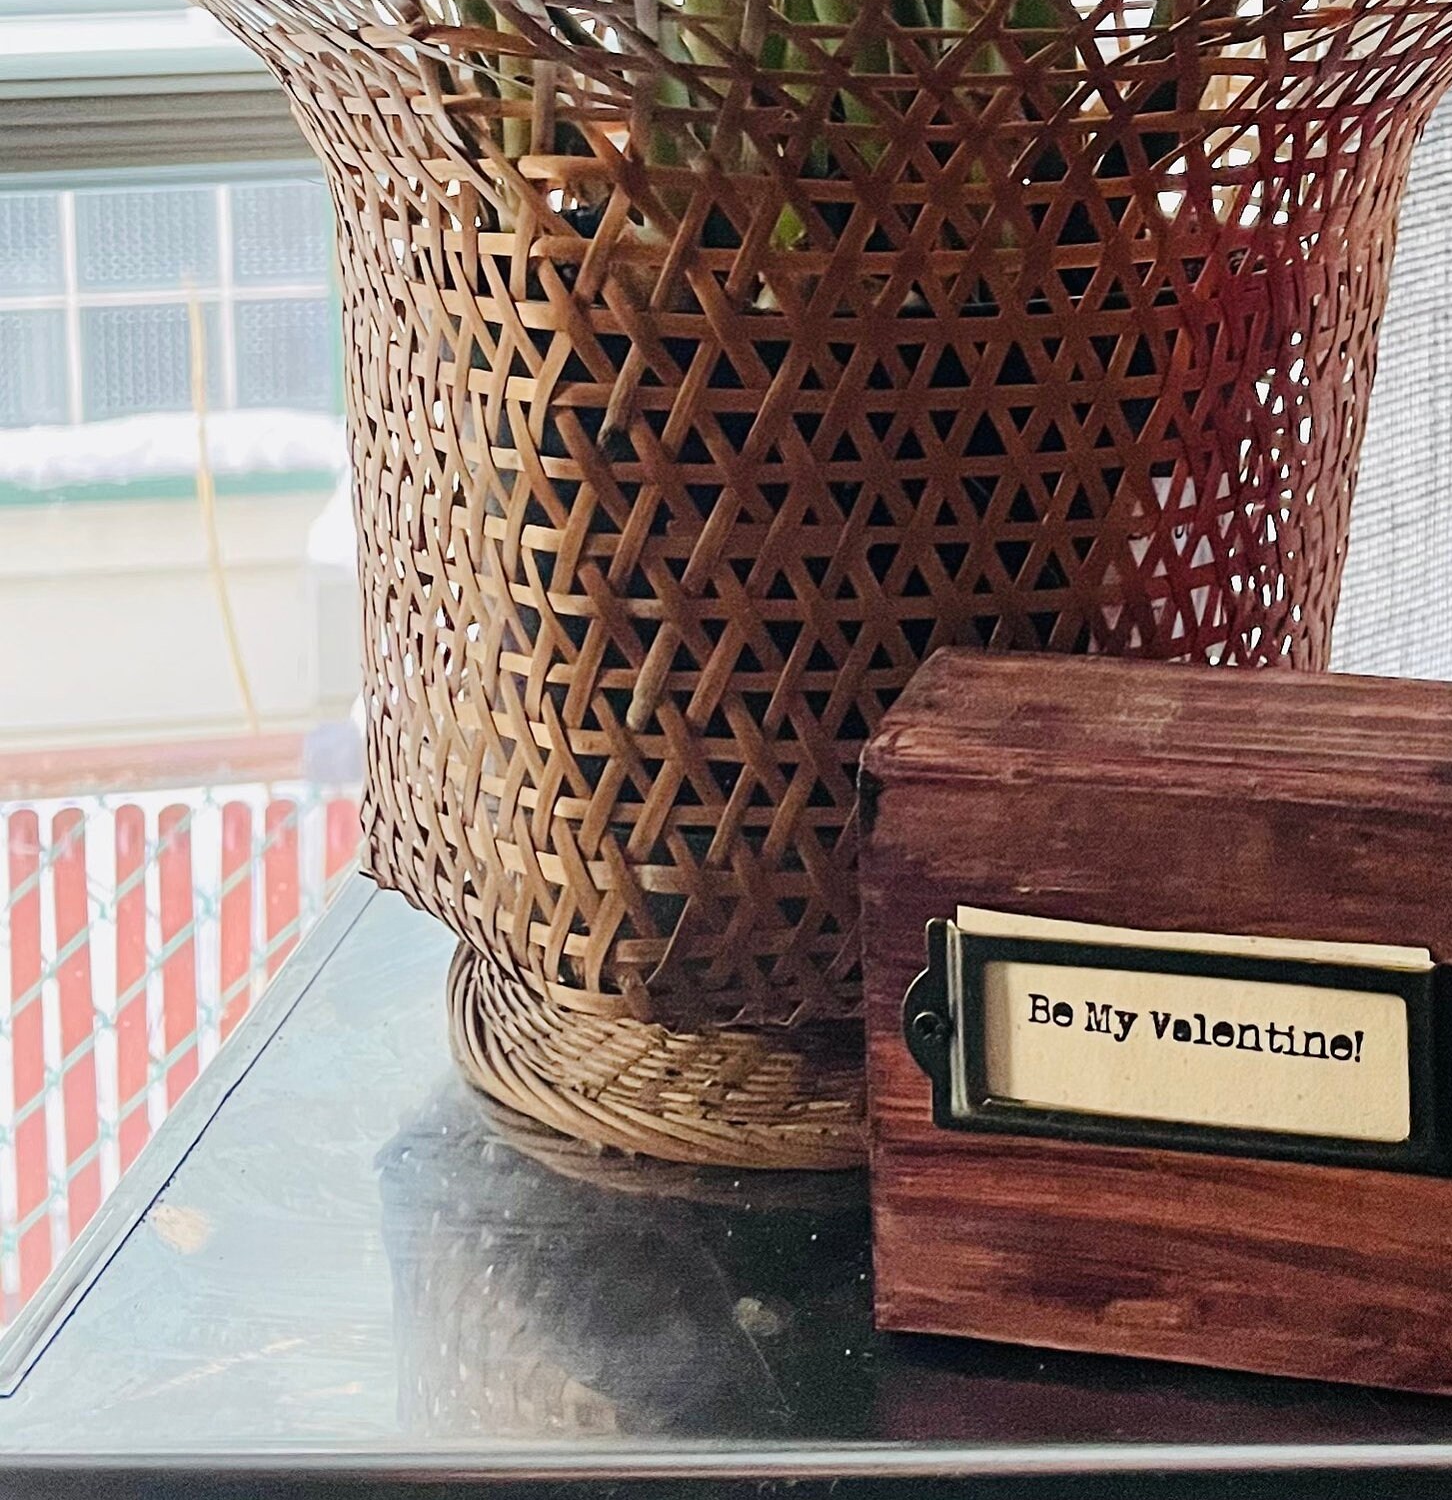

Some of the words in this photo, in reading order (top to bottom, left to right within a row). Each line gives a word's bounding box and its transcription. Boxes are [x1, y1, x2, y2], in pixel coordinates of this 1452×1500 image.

[1027, 993, 1074, 1026] Be
[1084, 1001, 1139, 1043] My
[1149, 1010, 1365, 1063] Valentine!
